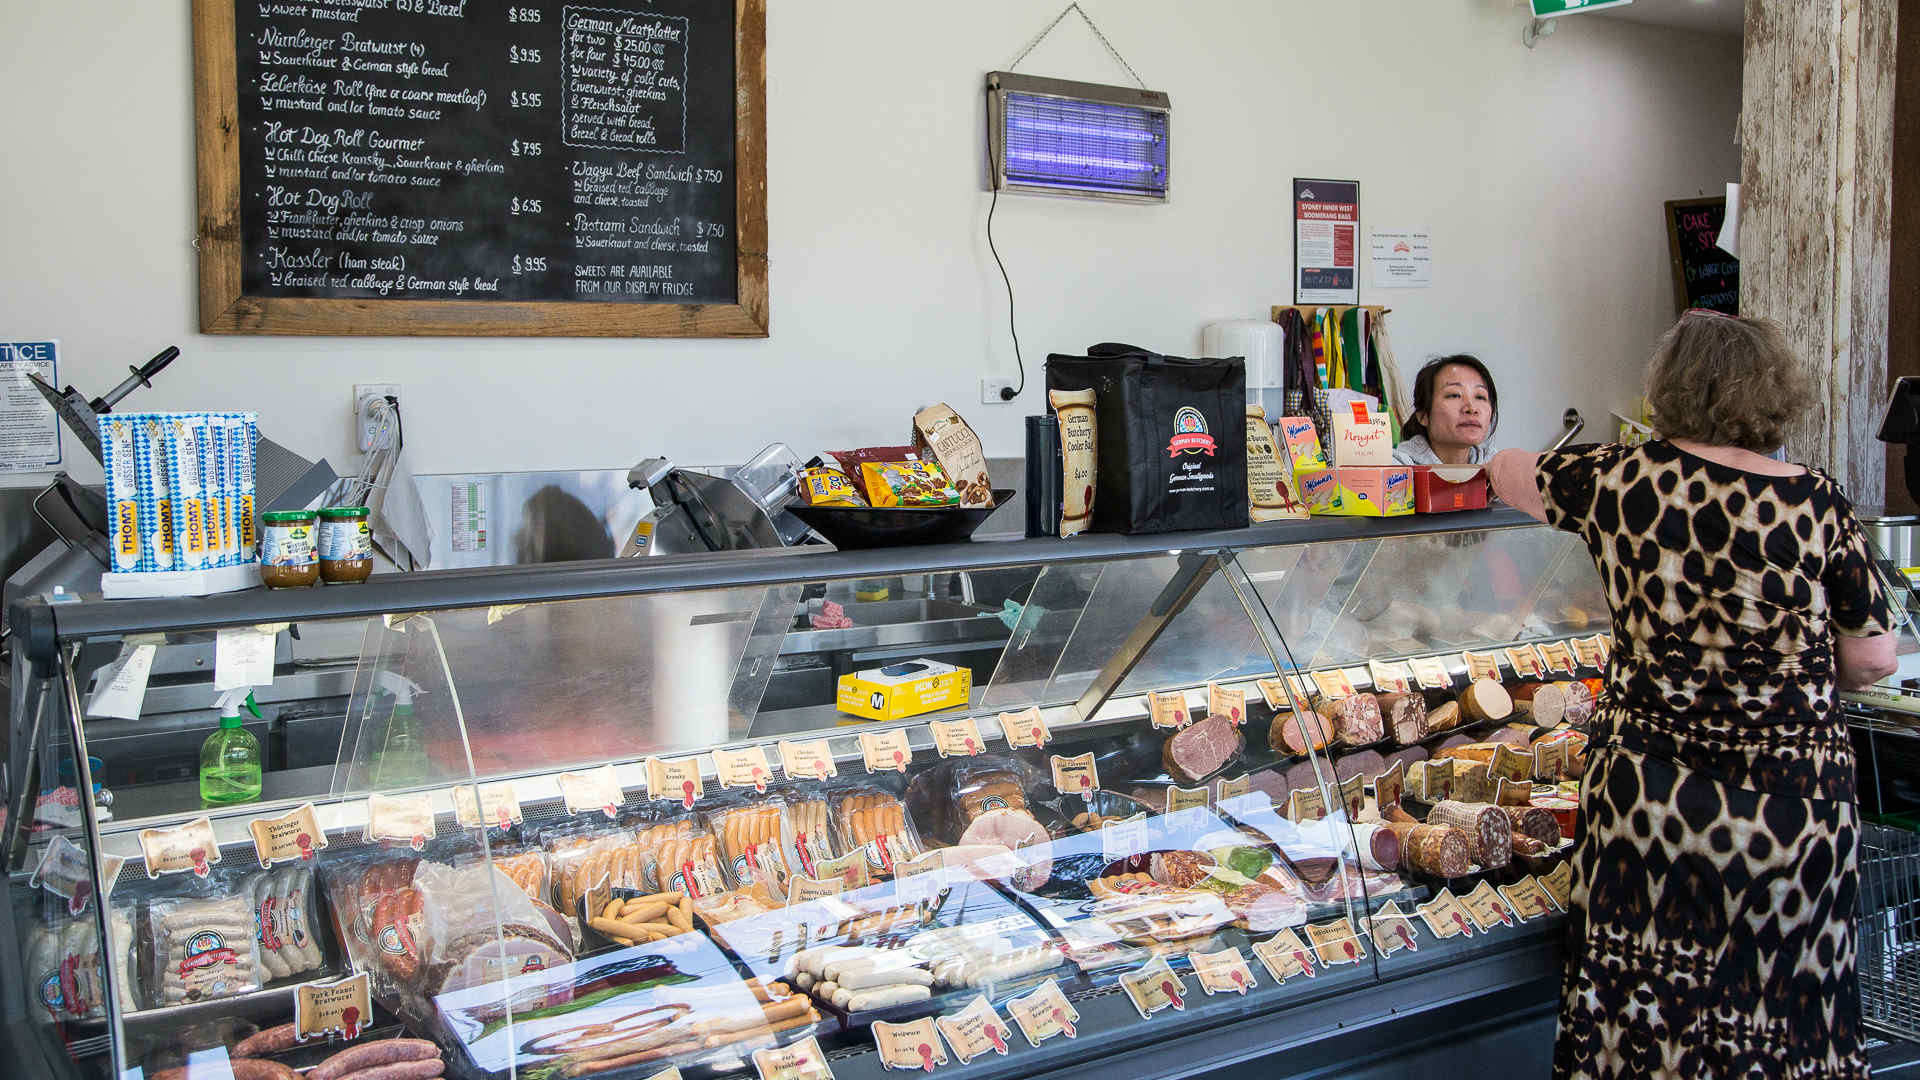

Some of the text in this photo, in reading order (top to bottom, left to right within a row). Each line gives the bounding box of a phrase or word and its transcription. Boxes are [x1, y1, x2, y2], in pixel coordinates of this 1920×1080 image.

[272, 4, 360, 22] sweet mustard
[415, 0, 424, 13] &
[567, 13, 681, 41] German Meatplatter
[258, 26, 425, 58] Nürnberger Bratwurst (4)
[569, 31, 584, 46] for
[586, 35, 606, 45] two
[273, 51, 449, 79] Sauerkraut & German style bread
[570, 45, 585, 60] for
[585, 50, 607, 65] four
[582, 66, 618, 84] variety
[621, 71, 632, 86] of
[634, 71, 656, 85] cold
[259, 72, 487, 112] Leberkäse Roll (fine or coarse meatloaf)
[626, 86, 666, 104] gherkins
[275, 98, 322, 112] mustard
[369, 101, 404, 117] tomato
[408, 110, 441, 120] sauce
[571, 95, 642, 114] & Fleischsalat
[572, 112, 604, 125] served
[606, 114, 626, 127] with
[264, 121, 425, 151] Hot Dog Roll Gourmet
[601, 129, 608, 141] &
[609, 129, 634, 143] bread
[636, 131, 657, 145] rolls
[277, 149, 305, 162] Chilli
[308, 149, 339, 165] Cheese
[397, 153, 452, 170] Sauerkraut
[455, 161, 463, 171] &
[465, 158, 504, 174] gherkins
[279, 166, 329, 180] mustard
[368, 171, 407, 185] tomato
[411, 175, 441, 187] sauce
[572, 161, 693, 184] Wagyu Beef Sandwich
[267, 185, 373, 215] Hot Dog Roll
[573, 193, 592, 205] and
[621, 196, 650, 208] toasted
[584, 180, 669, 203] braised red cabbage
[343, 212, 388, 231] gherkins
[391, 216, 399, 229] &
[400, 215, 425, 231] crisp
[430, 217, 464, 232] onions
[575, 213, 681, 237] Pastrami Sandwich
[281, 226, 333, 240] mustard
[372, 229, 407, 245] tomato
[409, 234, 439, 246] sauce
[584, 235, 631, 250] Sauerkraut
[634, 238, 649, 250] and
[680, 241, 709, 253] toasted
[266, 247, 406, 271] Kassler (ham steak)
[575, 265, 673, 279] SWEETS ARE AVAILABLE
[284, 272, 500, 296] braised red cabbage & German style bread
[575, 280, 695, 296] FROM OUR DISPLAY FRIDGE
[1067, 414, 1089, 424] German
[1067, 426, 1092, 439] Butchery
[1344, 428, 1385, 448] Nougat
[1067, 439, 1085, 452] Cooler
[121, 503, 135, 553] THOMY
[161, 501, 173, 552] THOMY
[188, 502, 200, 551] THOMY
[207, 501, 216, 549] THOMY
[242, 498, 251, 545] THOMY
[871, 694, 884, 709] M
